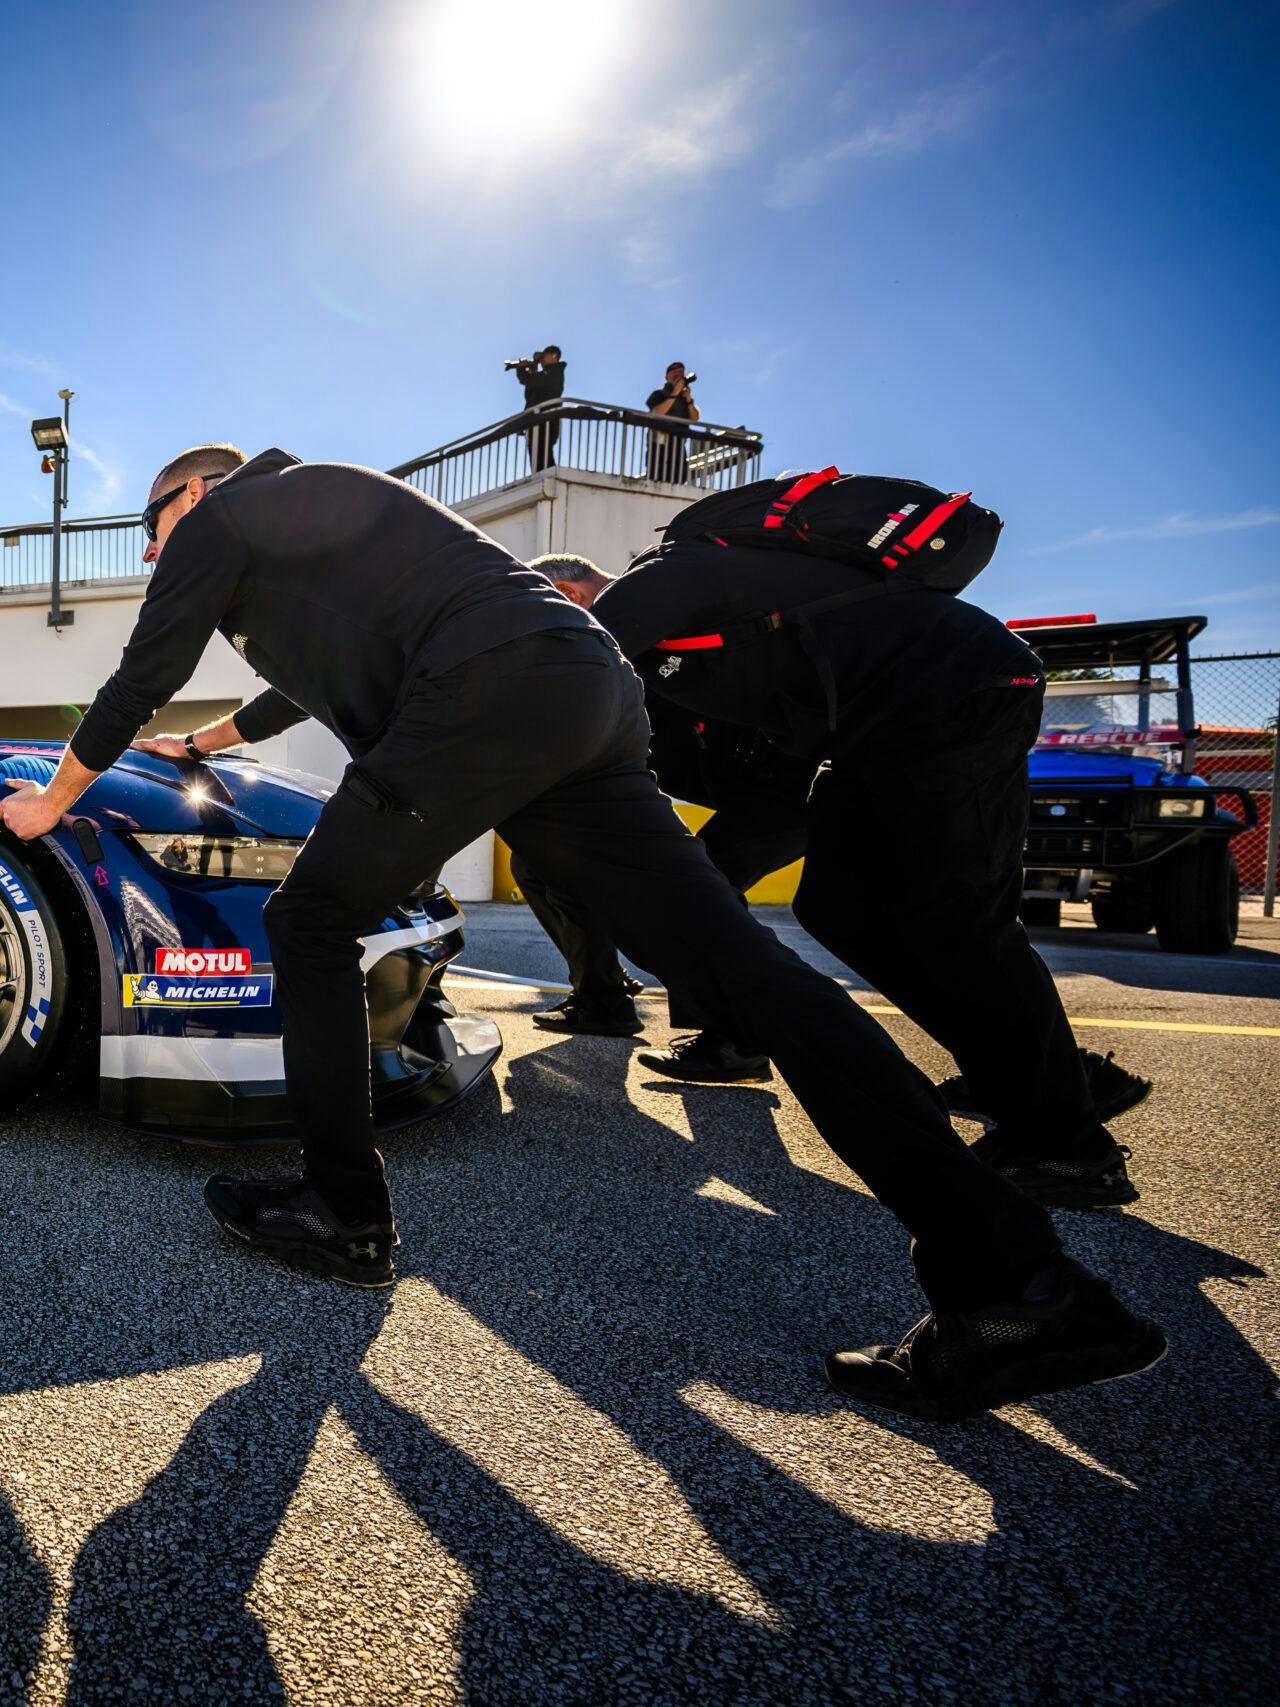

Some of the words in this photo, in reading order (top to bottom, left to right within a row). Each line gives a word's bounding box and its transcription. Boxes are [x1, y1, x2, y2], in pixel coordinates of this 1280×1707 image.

[1058, 732, 1162, 745] RESCUE
[27, 919, 43, 949] PILOT
[36, 952, 46, 988] SPORT
[161, 952, 247, 972] MOTUL
[165, 985, 260, 998] MICHELIN
